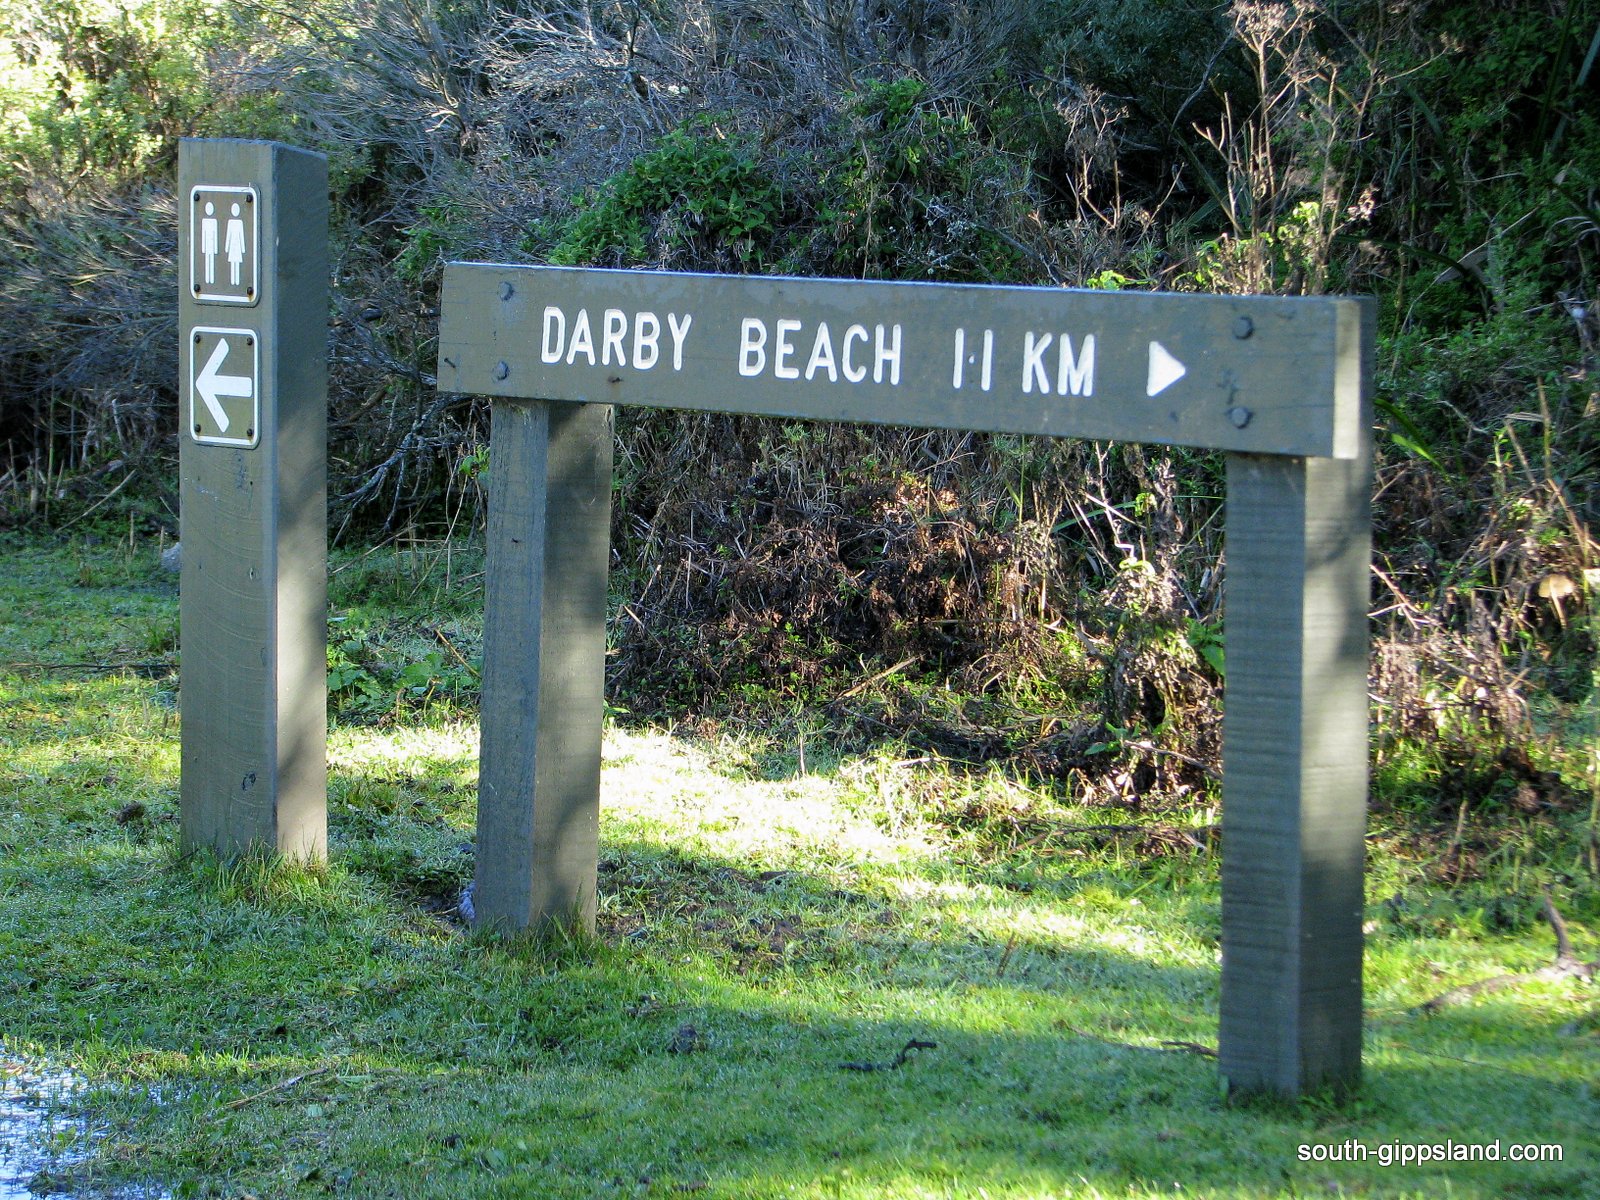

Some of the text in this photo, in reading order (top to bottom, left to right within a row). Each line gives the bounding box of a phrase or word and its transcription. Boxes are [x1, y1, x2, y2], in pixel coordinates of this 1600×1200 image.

[541, 306, 692, 370] DARBY
[738, 317, 902, 385] BEACH
[1022, 331, 1095, 396] KM
